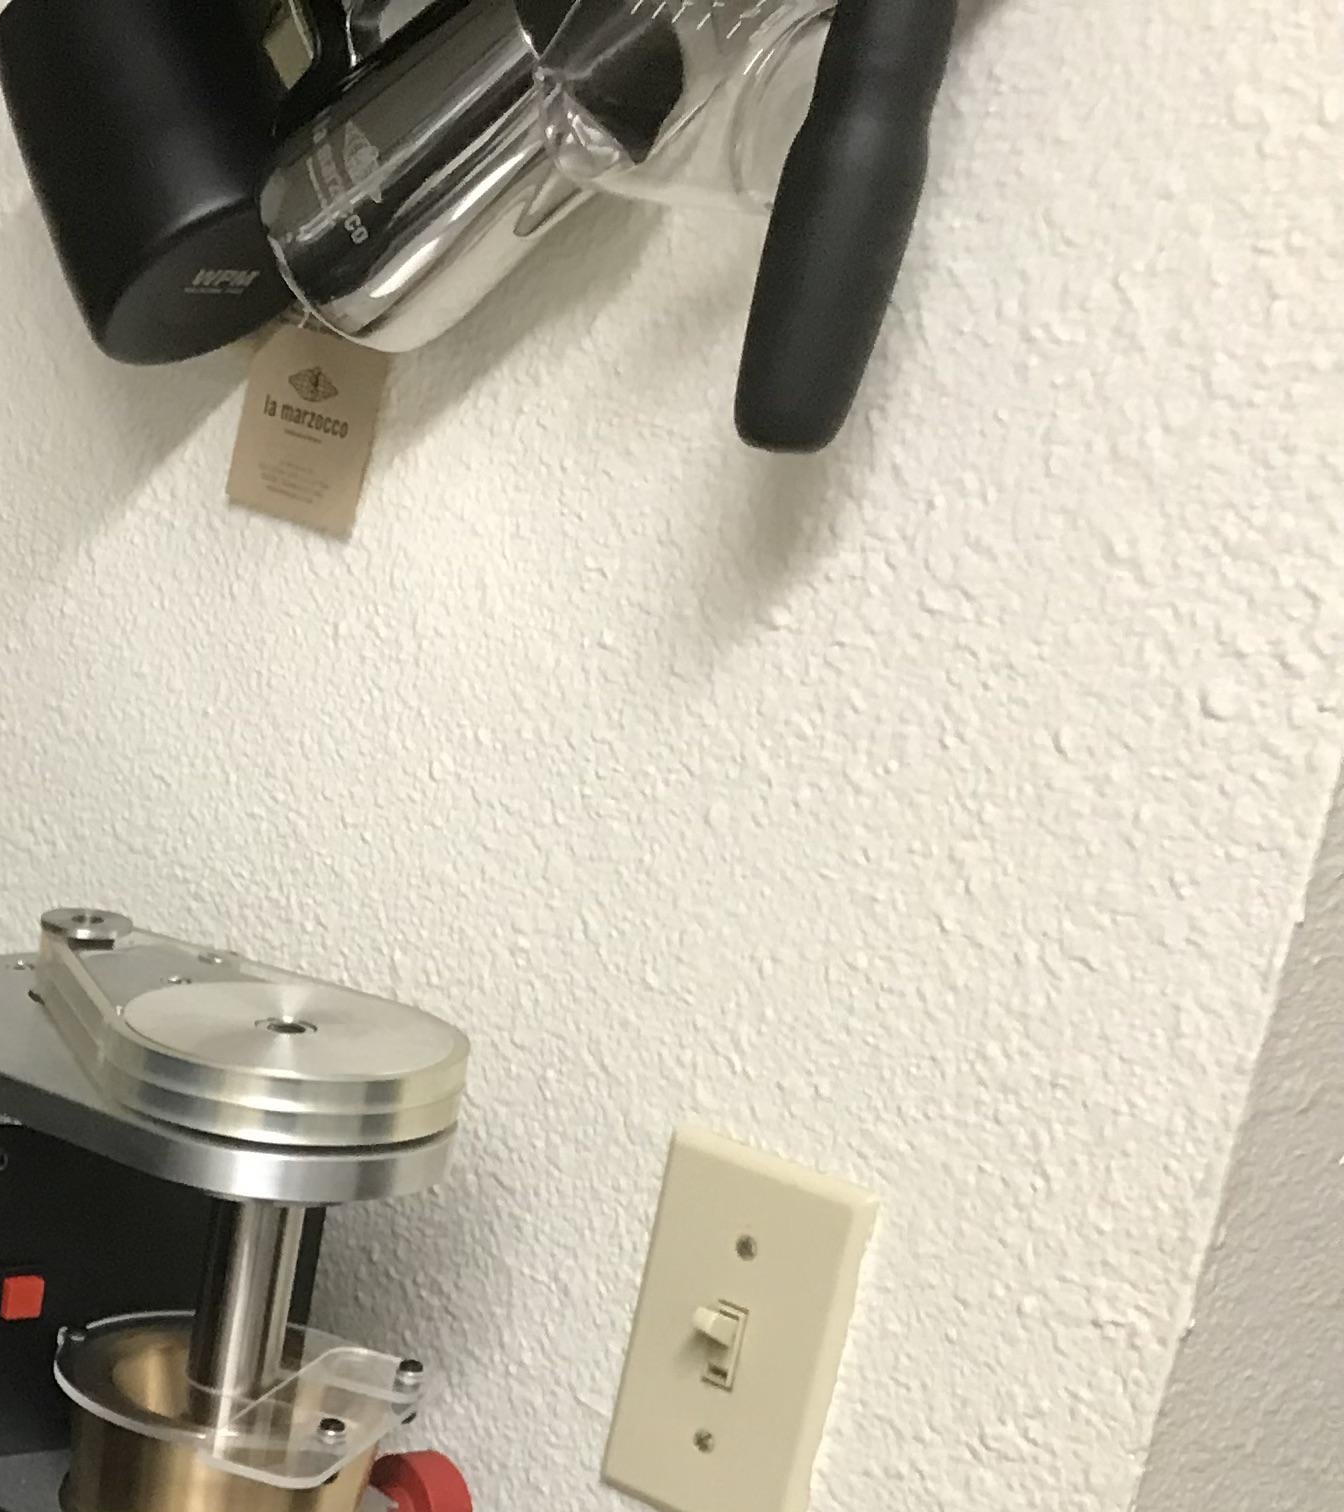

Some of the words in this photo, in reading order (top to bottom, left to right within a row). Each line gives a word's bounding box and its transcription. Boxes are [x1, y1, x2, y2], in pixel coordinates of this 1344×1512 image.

[192, 268, 260, 288] WPM
[263, 394, 278, 417] la
[279, 402, 350, 440] marzocco
